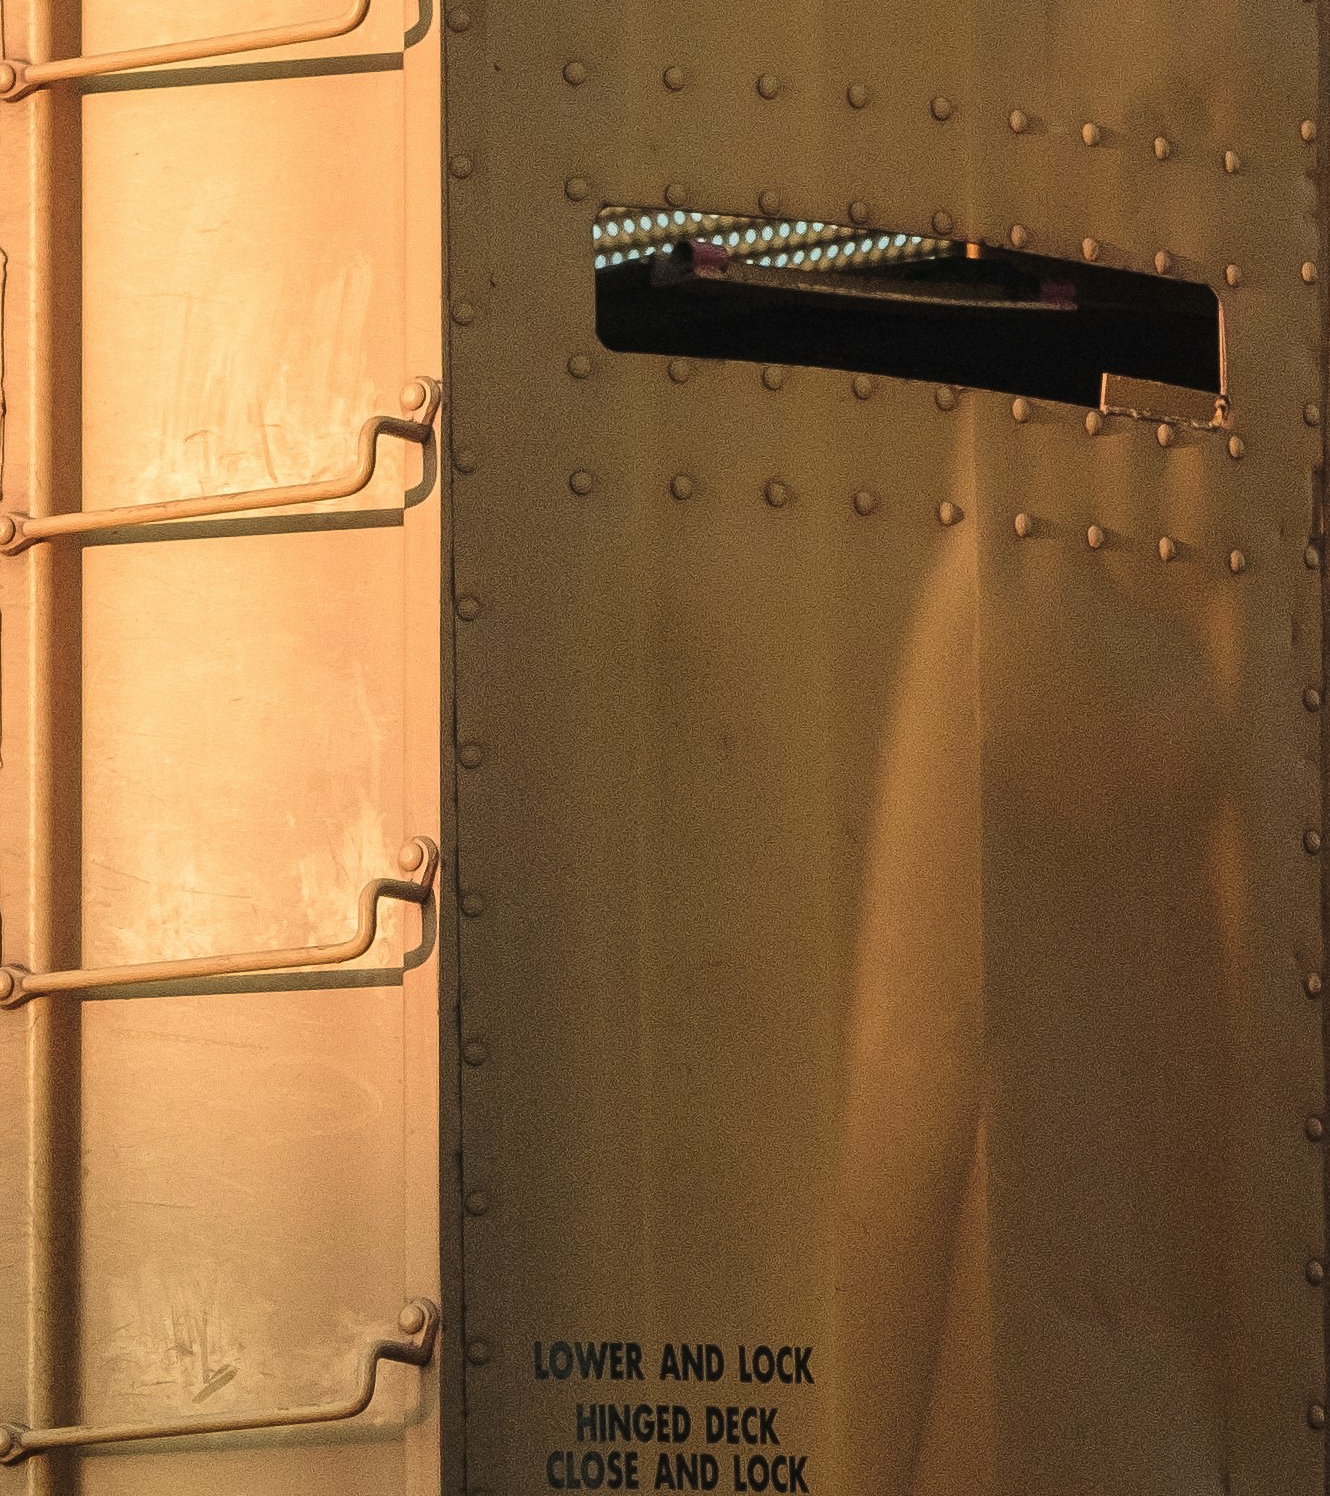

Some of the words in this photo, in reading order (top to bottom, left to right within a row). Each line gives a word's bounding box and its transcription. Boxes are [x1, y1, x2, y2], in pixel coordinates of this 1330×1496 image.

[533, 1341, 644, 1380] LOWER
[659, 1344, 724, 1381] AND
[739, 1346, 814, 1384] LOCK
[576, 1405, 691, 1442] HINGED
[706, 1407, 779, 1445] DECK
[546, 1451, 639, 1489] CLOSE
[654, 1453, 719, 1490] AND
[734, 1455, 809, 1493] LOCK
